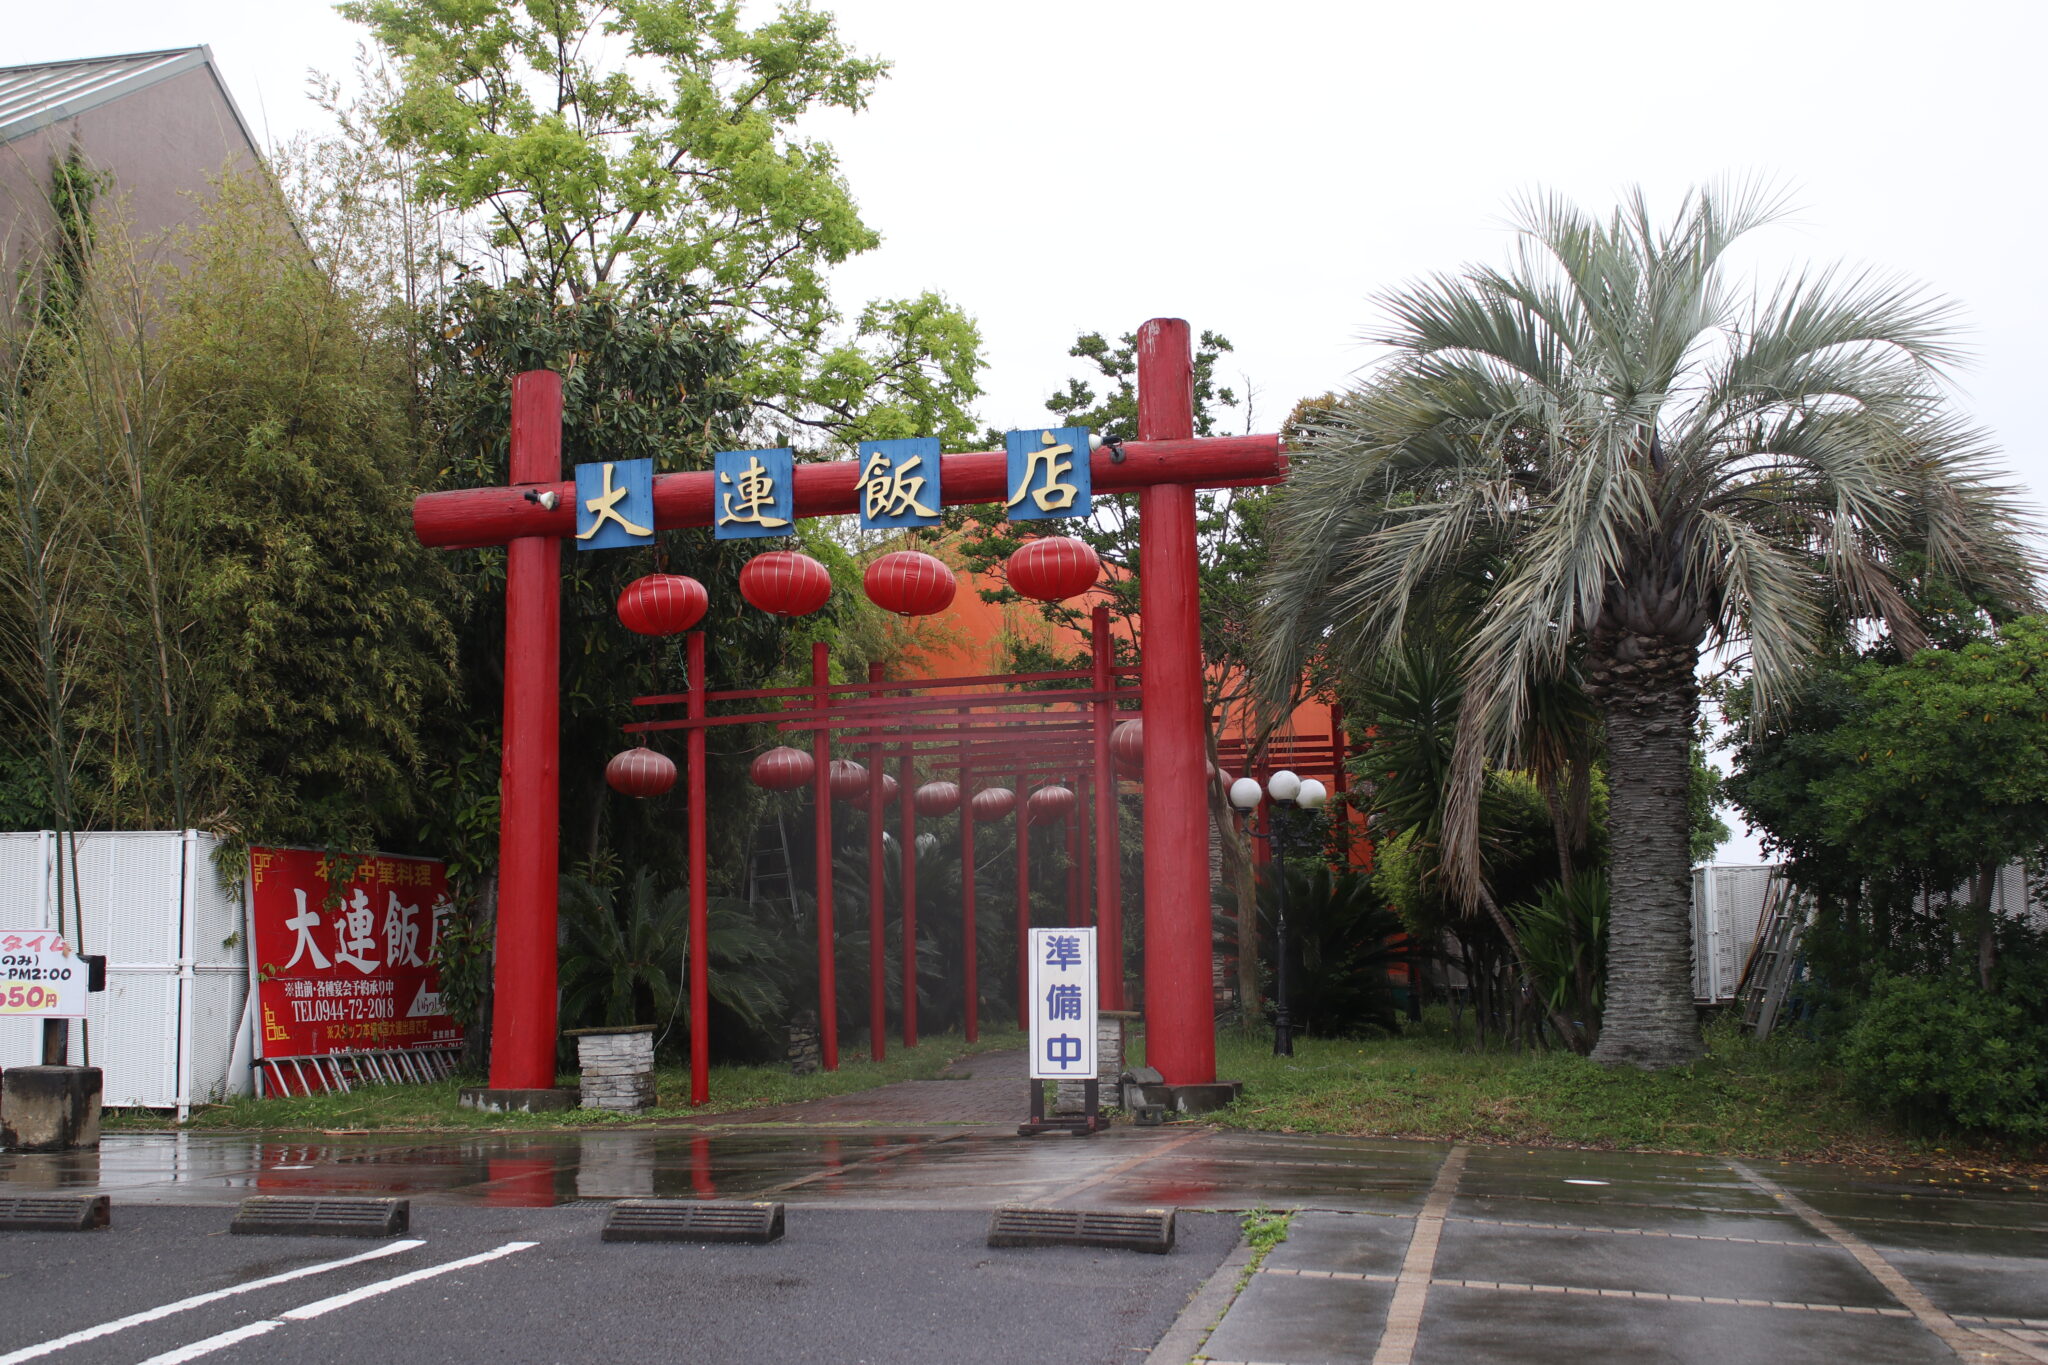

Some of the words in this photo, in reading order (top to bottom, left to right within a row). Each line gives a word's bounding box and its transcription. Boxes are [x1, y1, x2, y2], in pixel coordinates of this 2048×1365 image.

[576, 430, 1079, 540] 大連飯店
[314, 857, 432, 887] 本中華料理
[1045, 934, 1082, 1070] 準備中
